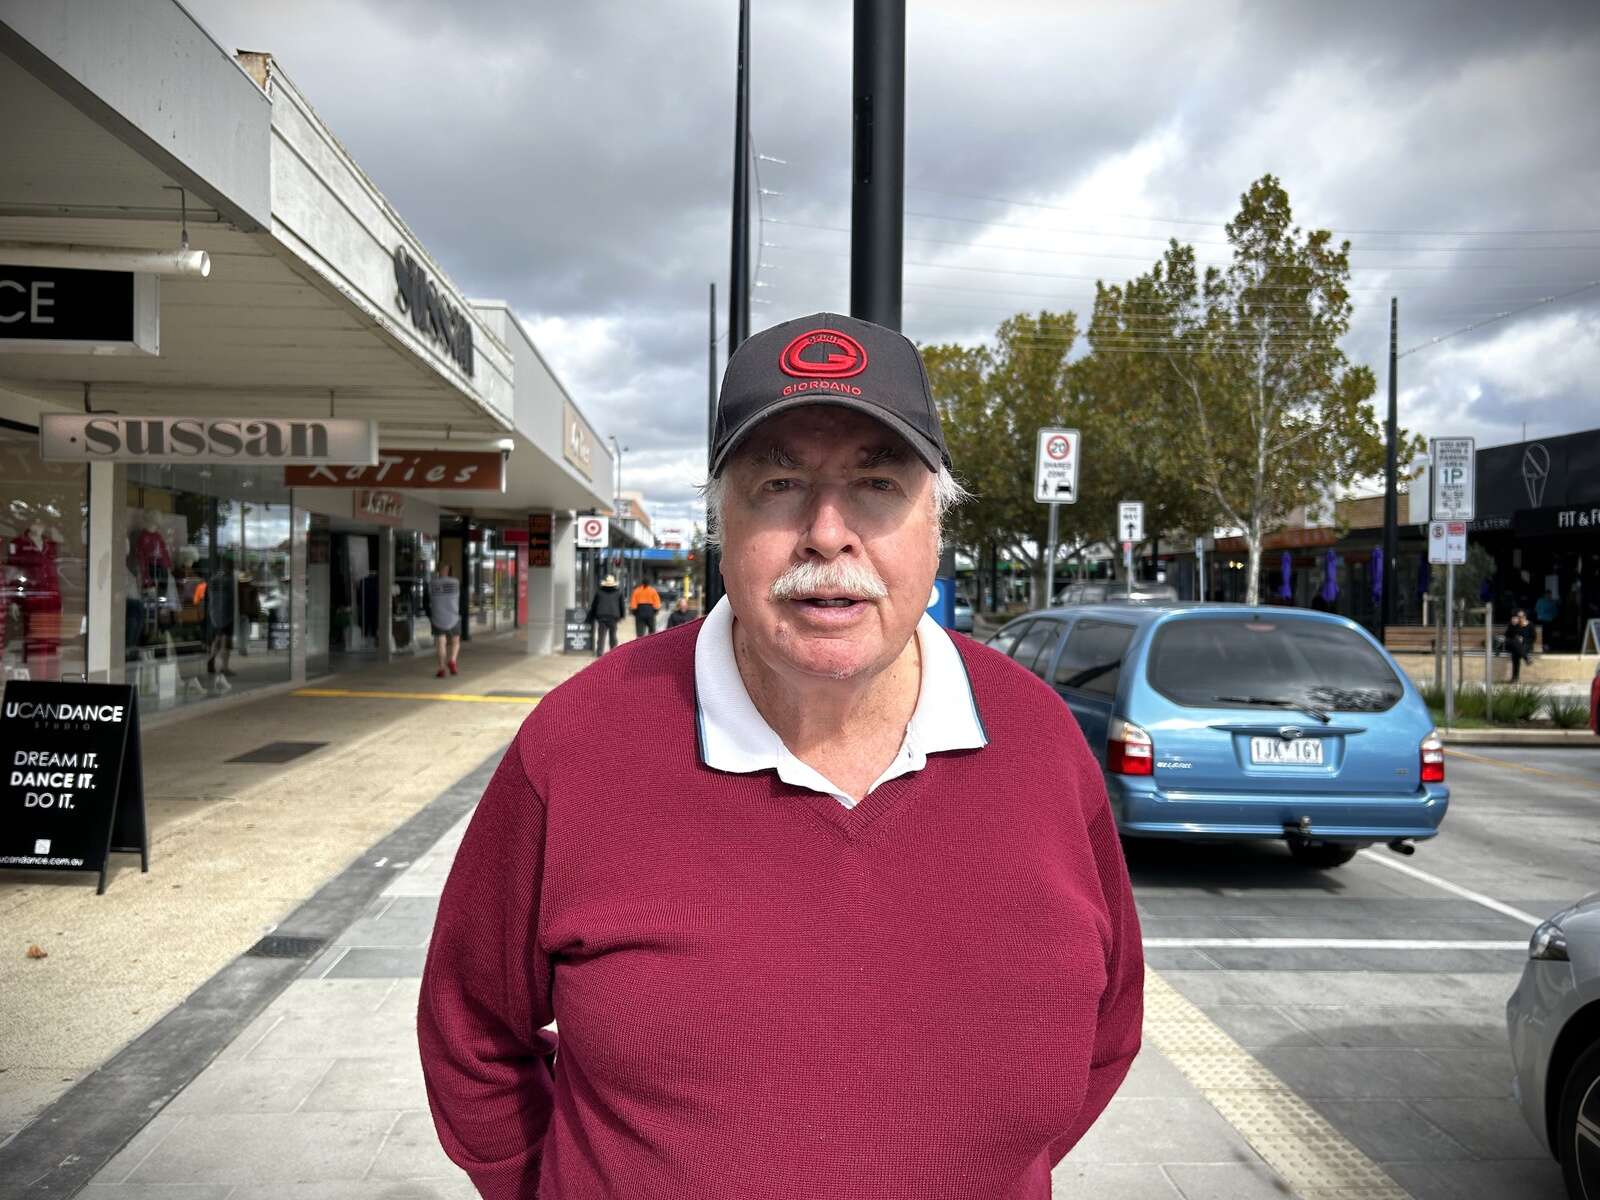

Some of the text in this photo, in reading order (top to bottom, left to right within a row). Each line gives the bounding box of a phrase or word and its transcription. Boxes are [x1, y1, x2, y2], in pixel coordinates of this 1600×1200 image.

[783, 380, 862, 396] GIORDANO
[84, 417, 329, 458] sussan
[1051, 441, 1066, 454] 20
[1443, 469, 1464, 484] 1P
[1558, 511, 1577, 528] FIT
[6, 702, 124, 722] UCANDANCE
[14, 750, 98, 769] DREAM IT.
[10, 771, 96, 790] DANCE IT.
[24, 791, 75, 810] DO IT.
